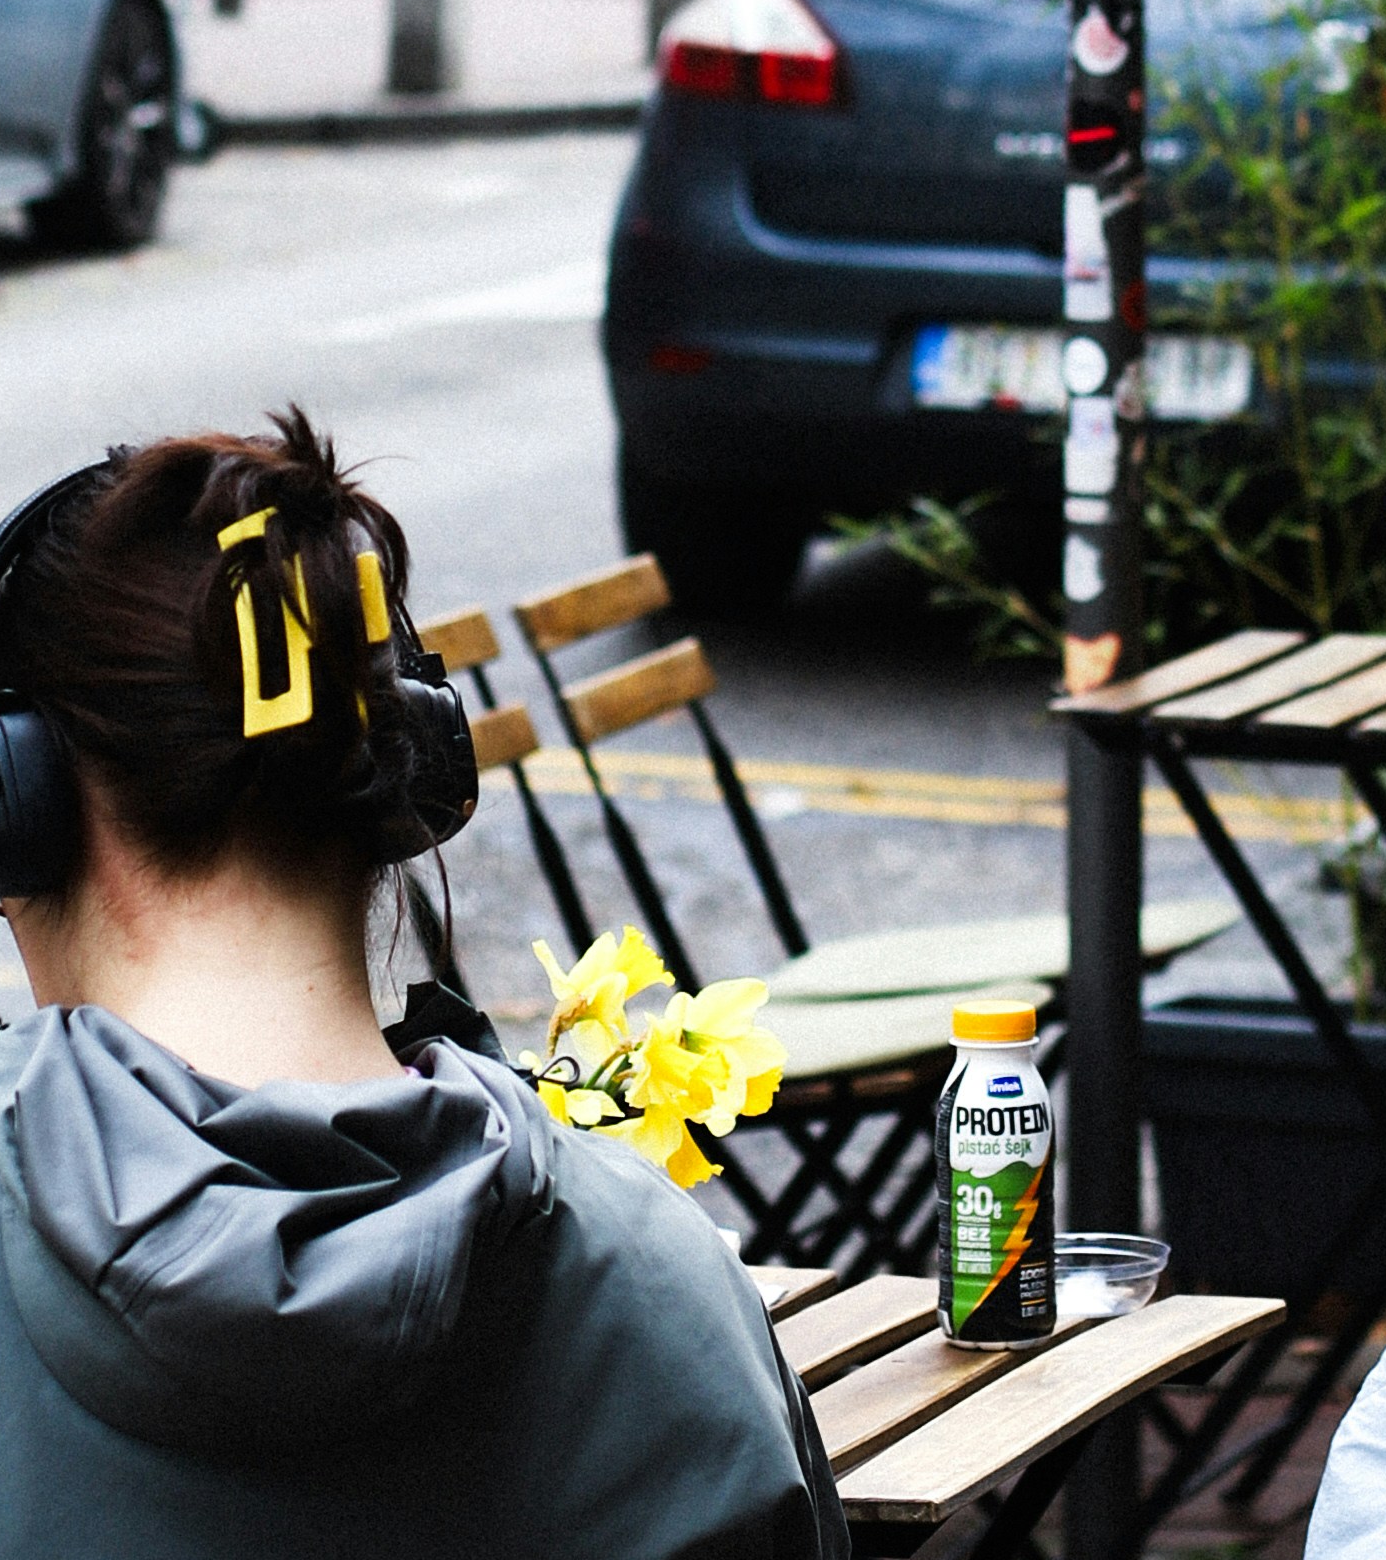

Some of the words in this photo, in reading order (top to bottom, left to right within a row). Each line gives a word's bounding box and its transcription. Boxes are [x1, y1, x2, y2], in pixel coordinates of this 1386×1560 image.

[955, 1101, 1050, 1137] PROTEIN
[957, 1137, 1001, 1157] pistać
[1004, 1137, 1033, 1159] šejk
[957, 1225, 991, 1242] BEZ
